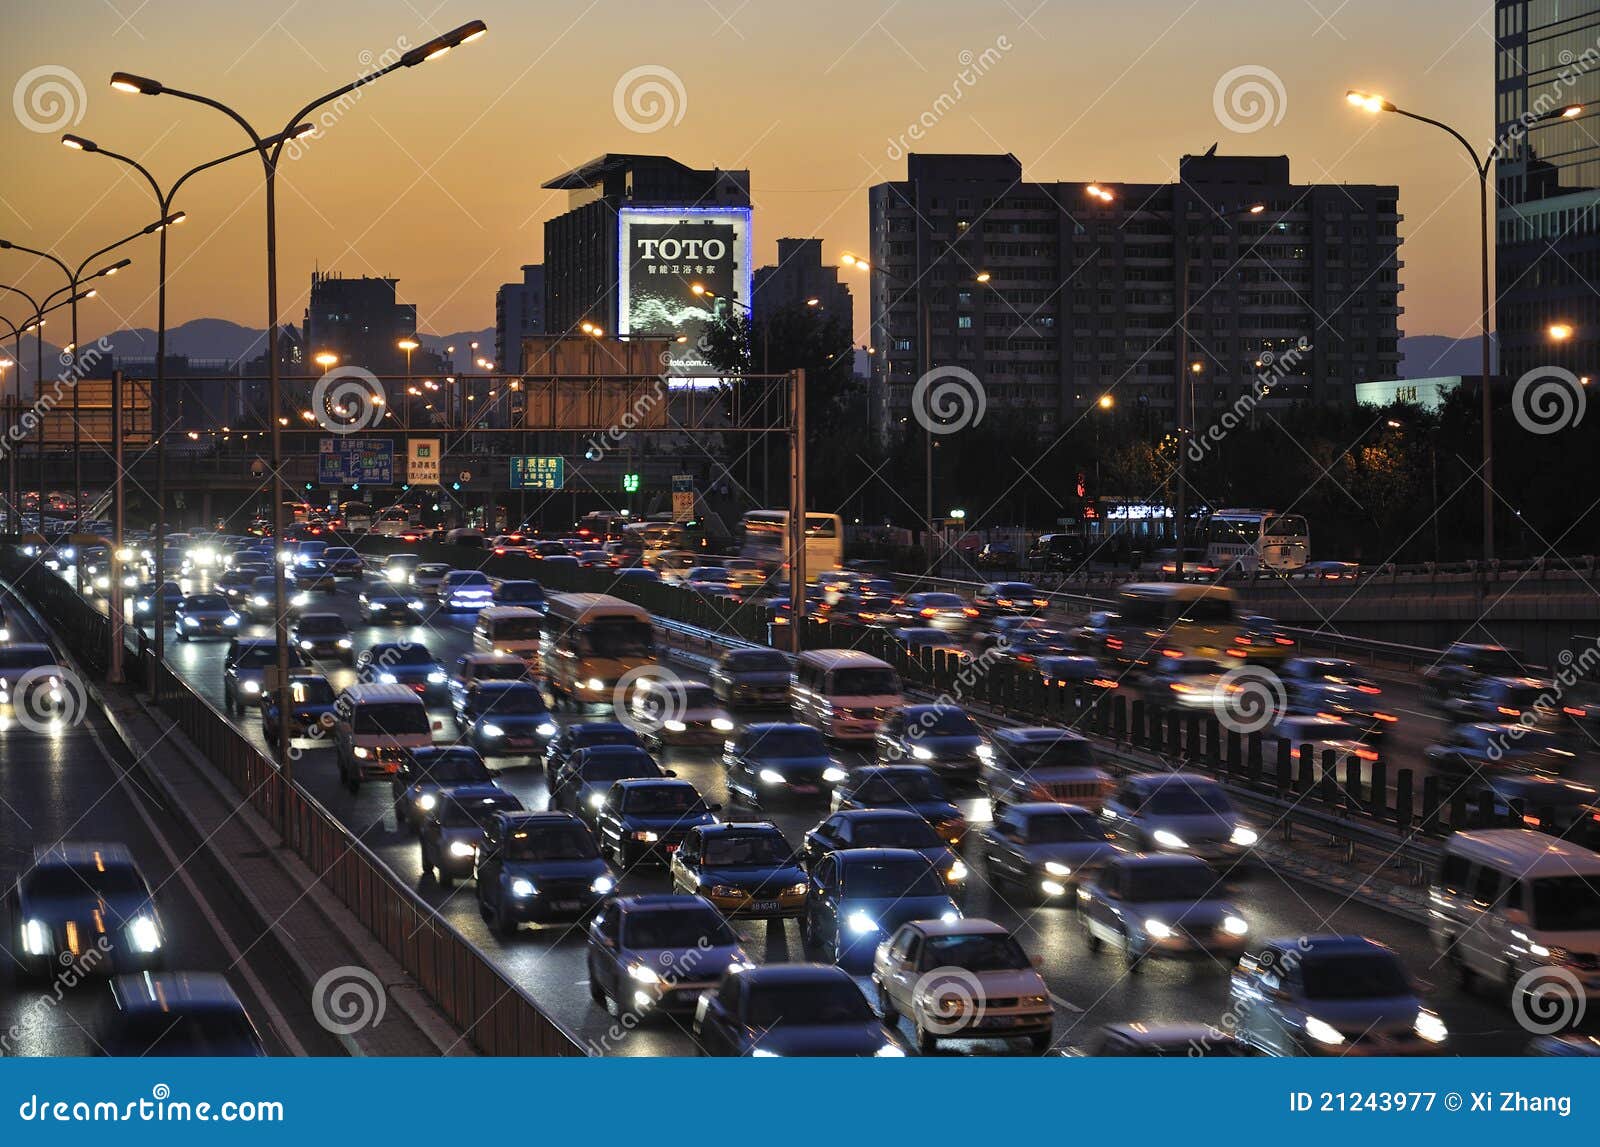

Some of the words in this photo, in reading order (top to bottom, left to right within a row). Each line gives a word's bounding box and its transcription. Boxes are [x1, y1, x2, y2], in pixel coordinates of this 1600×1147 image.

[637, 238, 726, 260] TOTO
[648, 264, 716, 275] 智能卫浴专家
[669, 359, 712, 367] toto.com.c
